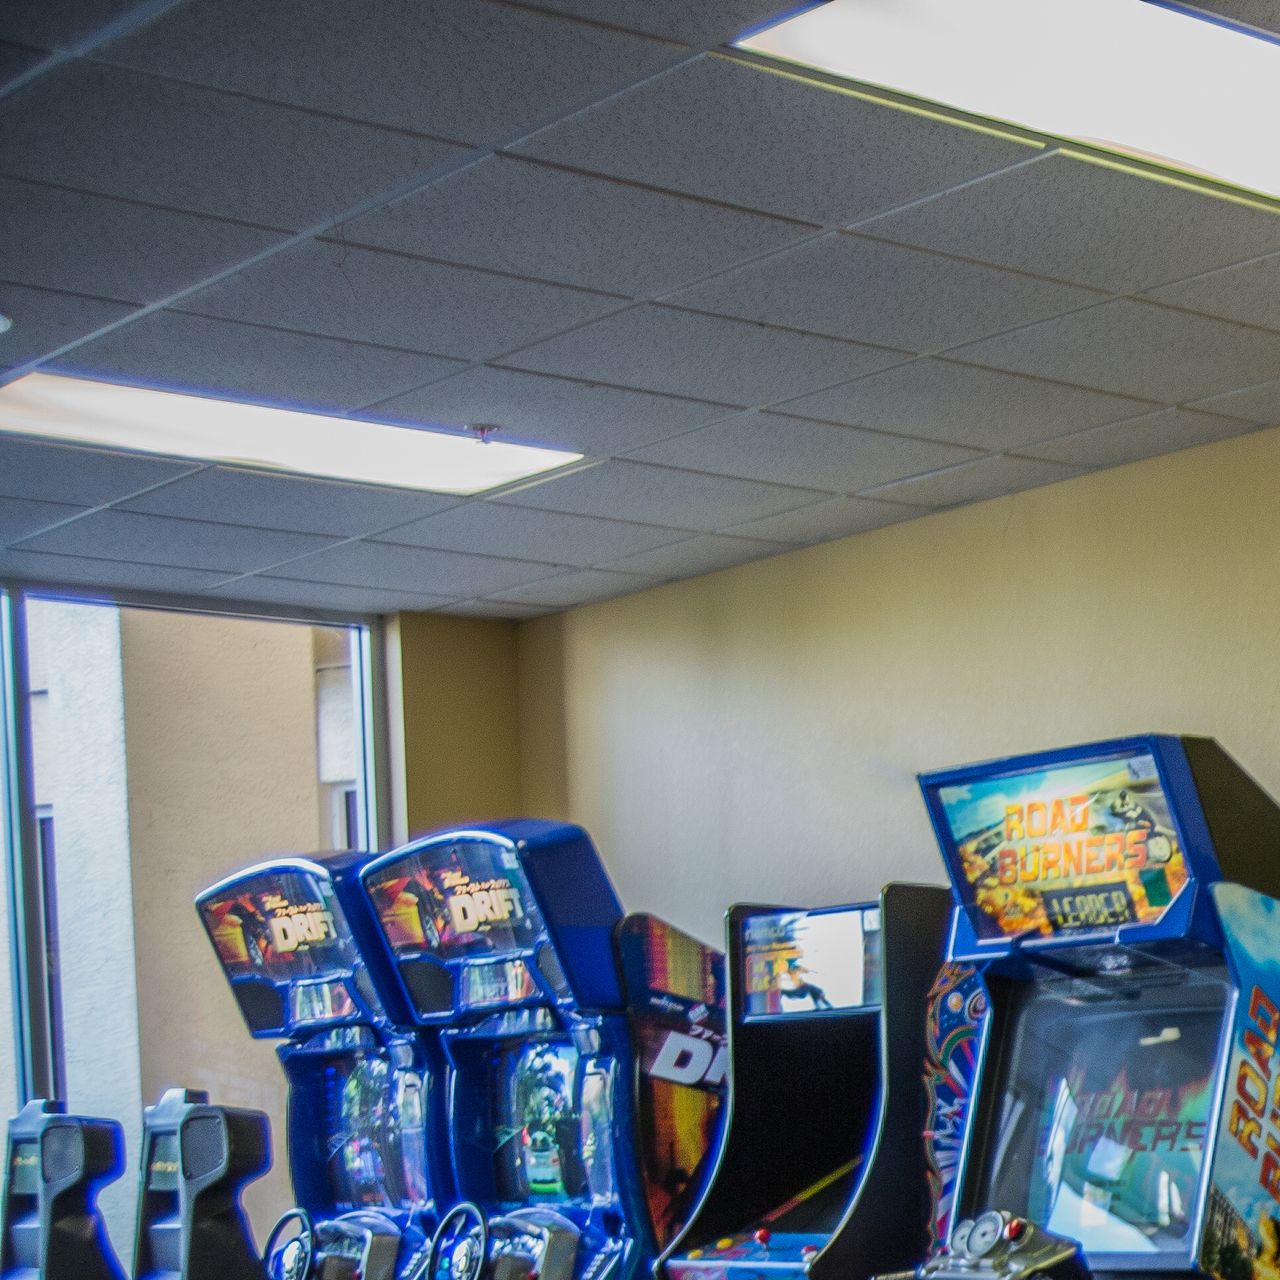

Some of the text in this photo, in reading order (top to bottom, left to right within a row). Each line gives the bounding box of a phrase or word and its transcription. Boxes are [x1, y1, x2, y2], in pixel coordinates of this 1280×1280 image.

[1005, 794, 1089, 841] ROAD
[997, 829, 1148, 885] BURNERS
[271, 911, 337, 952] DRIFT
[450, 887, 523, 933] DRIFT
[1228, 984, 1280, 1160] ROAD
